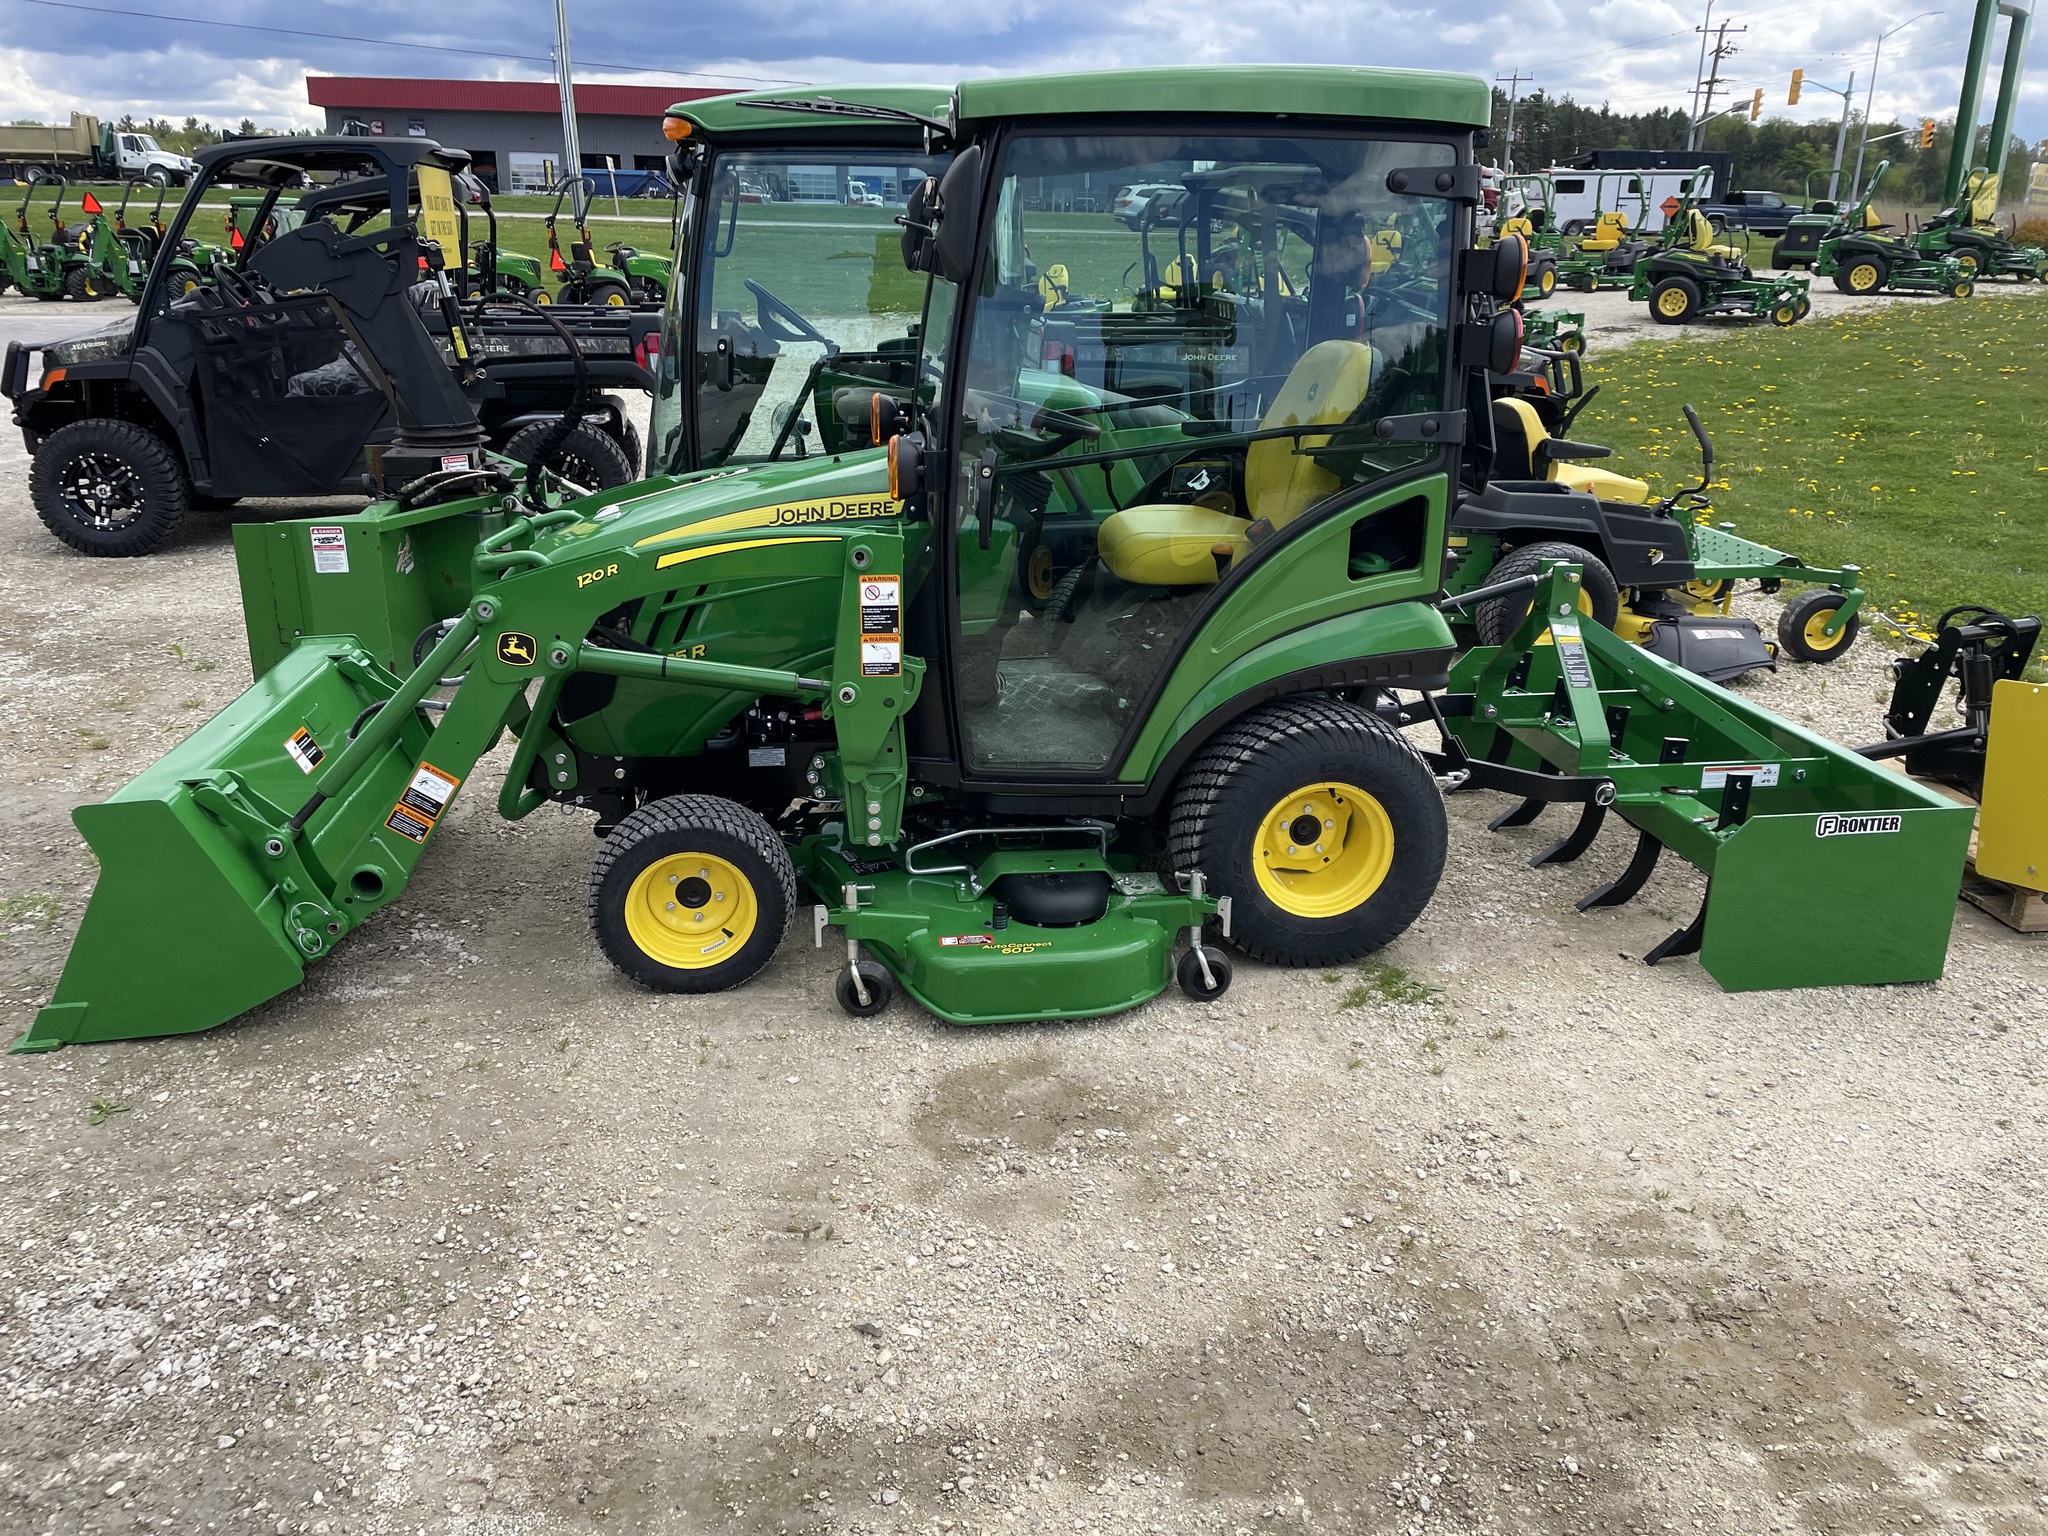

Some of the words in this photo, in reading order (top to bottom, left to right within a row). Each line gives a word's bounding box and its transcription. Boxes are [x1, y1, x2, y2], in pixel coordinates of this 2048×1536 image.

[1182, 353, 1207, 361] JOHN
[1207, 353, 1237, 361] DEERE
[769, 506, 825, 526] JOHN
[829, 501, 895, 518] DEERE
[1817, 816, 1900, 836] FRONTIER
